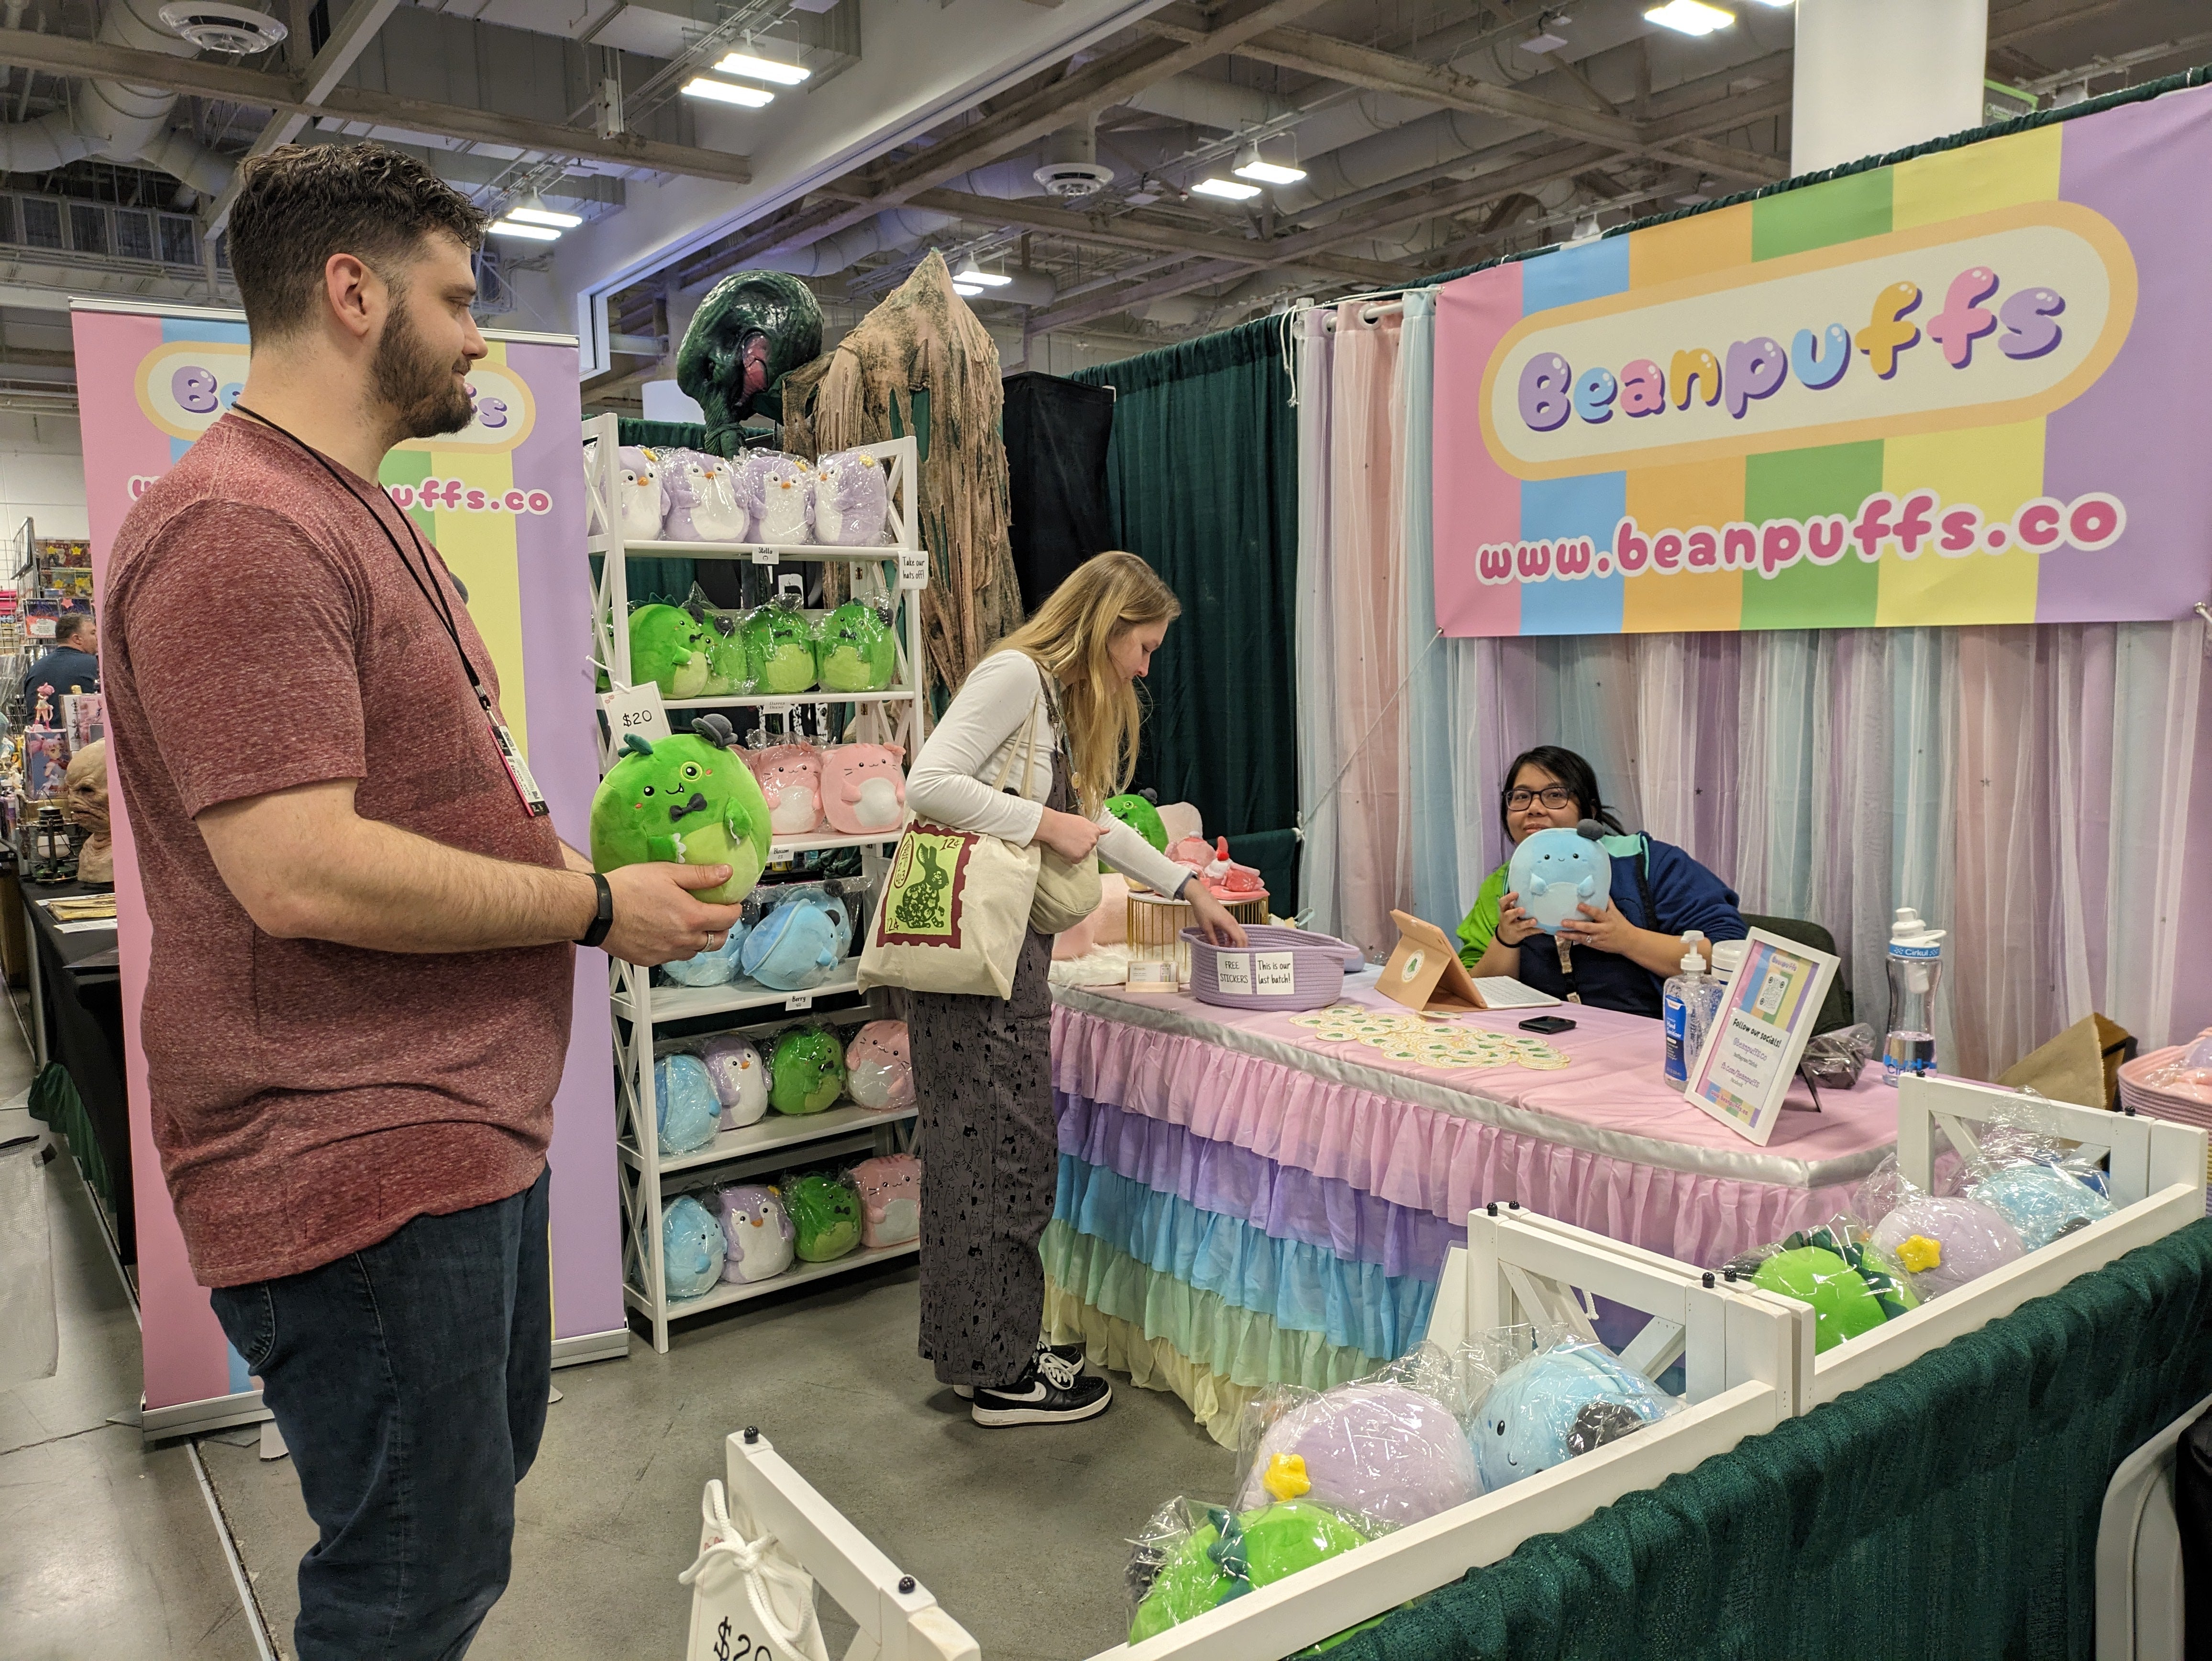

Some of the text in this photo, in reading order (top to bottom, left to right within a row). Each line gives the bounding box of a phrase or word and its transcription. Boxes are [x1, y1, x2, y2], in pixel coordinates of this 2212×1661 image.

[1517, 266, 2066, 431] Beanpuffs
[1479, 494, 2118, 575] www.beanpuffs.co
[902, 556, 915, 566] Take
[903, 569, 924, 579] hats off!
[623, 710, 652, 727] $20
[1225, 961, 1239, 969] FREE
[1258, 960, 1271, 970] This
[1220, 974, 1248, 983] STICKERS
[1258, 973, 1291, 984] last batch!
[1733, 1019, 1782, 1048] Follow our socials!
